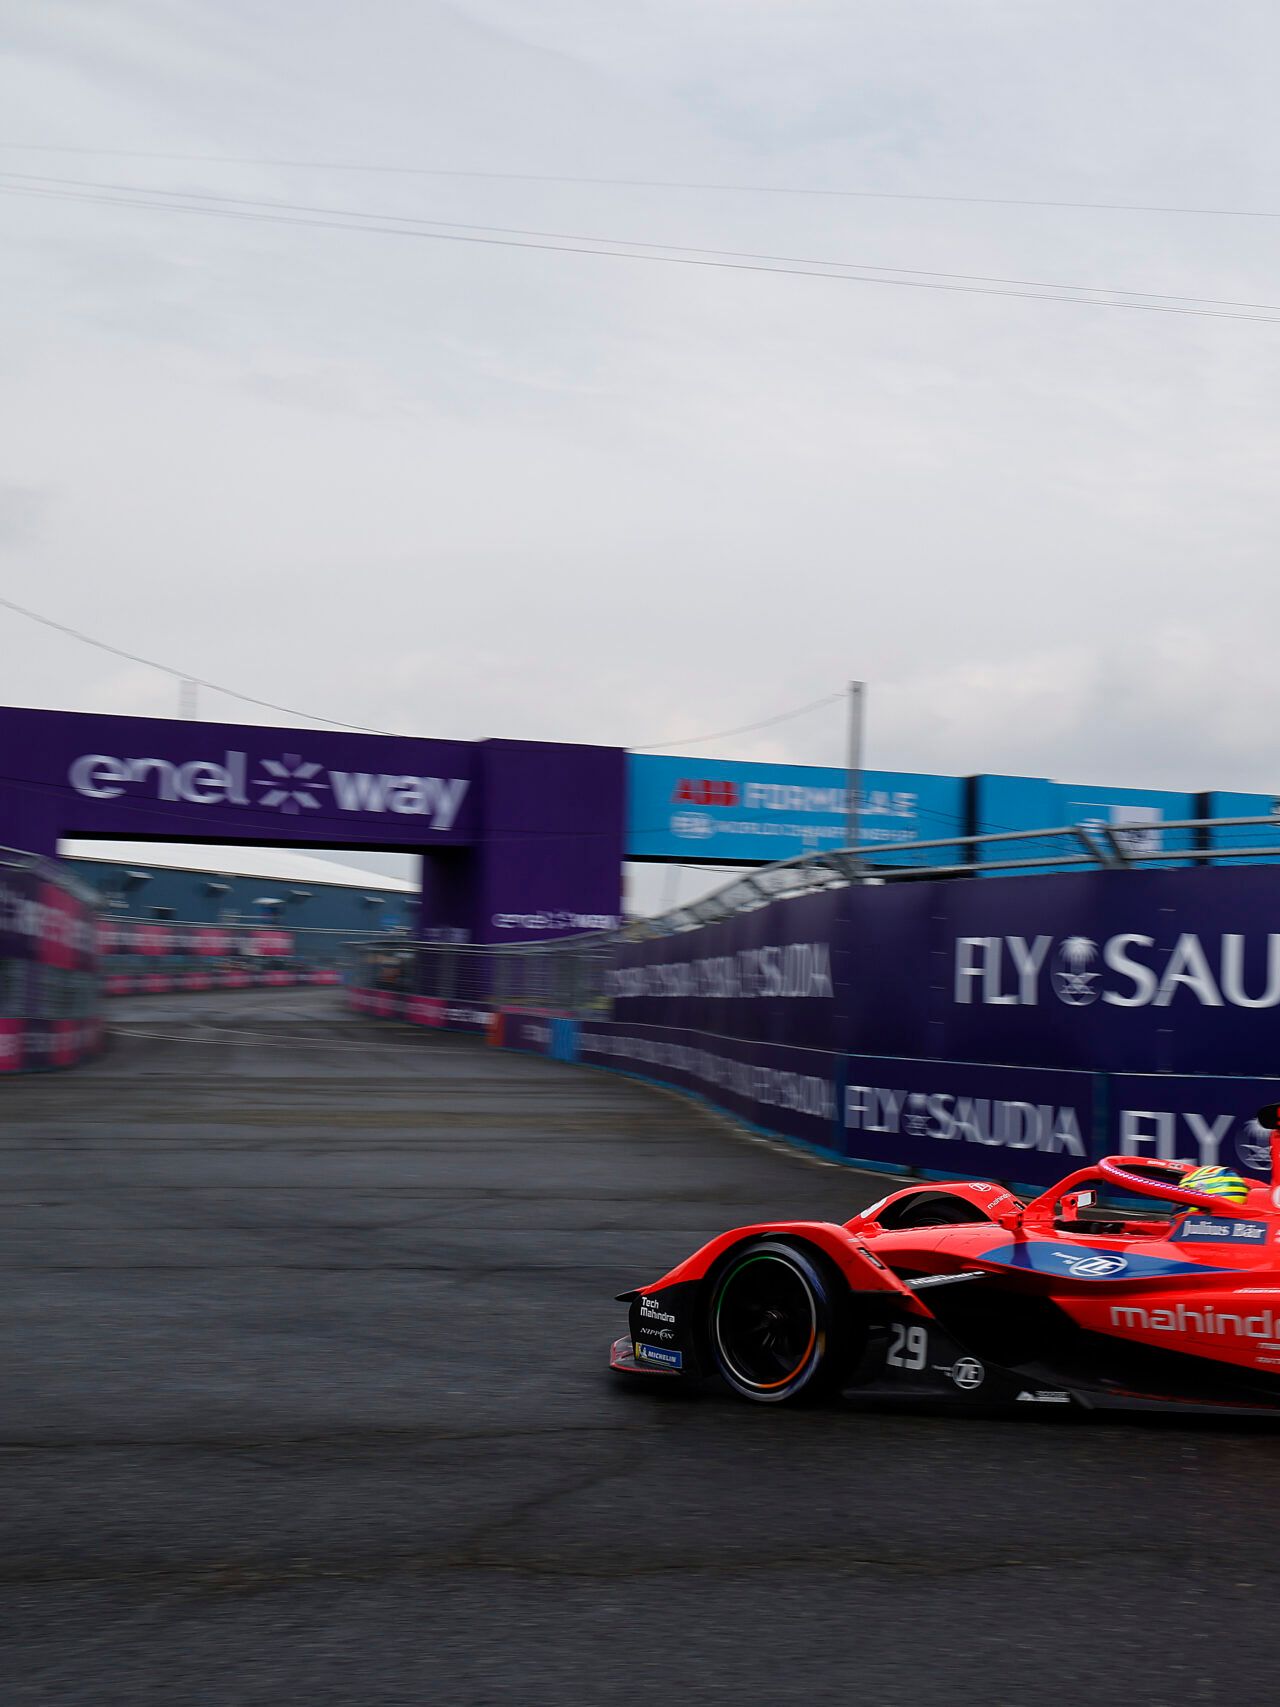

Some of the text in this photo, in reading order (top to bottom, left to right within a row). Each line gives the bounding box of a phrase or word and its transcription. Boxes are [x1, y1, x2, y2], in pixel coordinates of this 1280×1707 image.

[68, 750, 470, 831] enel way
[955, 934, 1053, 1005] FLY
[844, 1085, 1087, 1157] FLY SAUDIA
[1119, 1110, 1235, 1174] FLY
[1182, 1220, 1231, 1237] Julius
[640, 1306, 676, 1323] Mahindra
[641, 1296, 659, 1309] Tech
[640, 1327, 675, 1341] NIPPON
[887, 1322, 928, 1371] 29
[647, 1350, 677, 1363] MICHELIN
